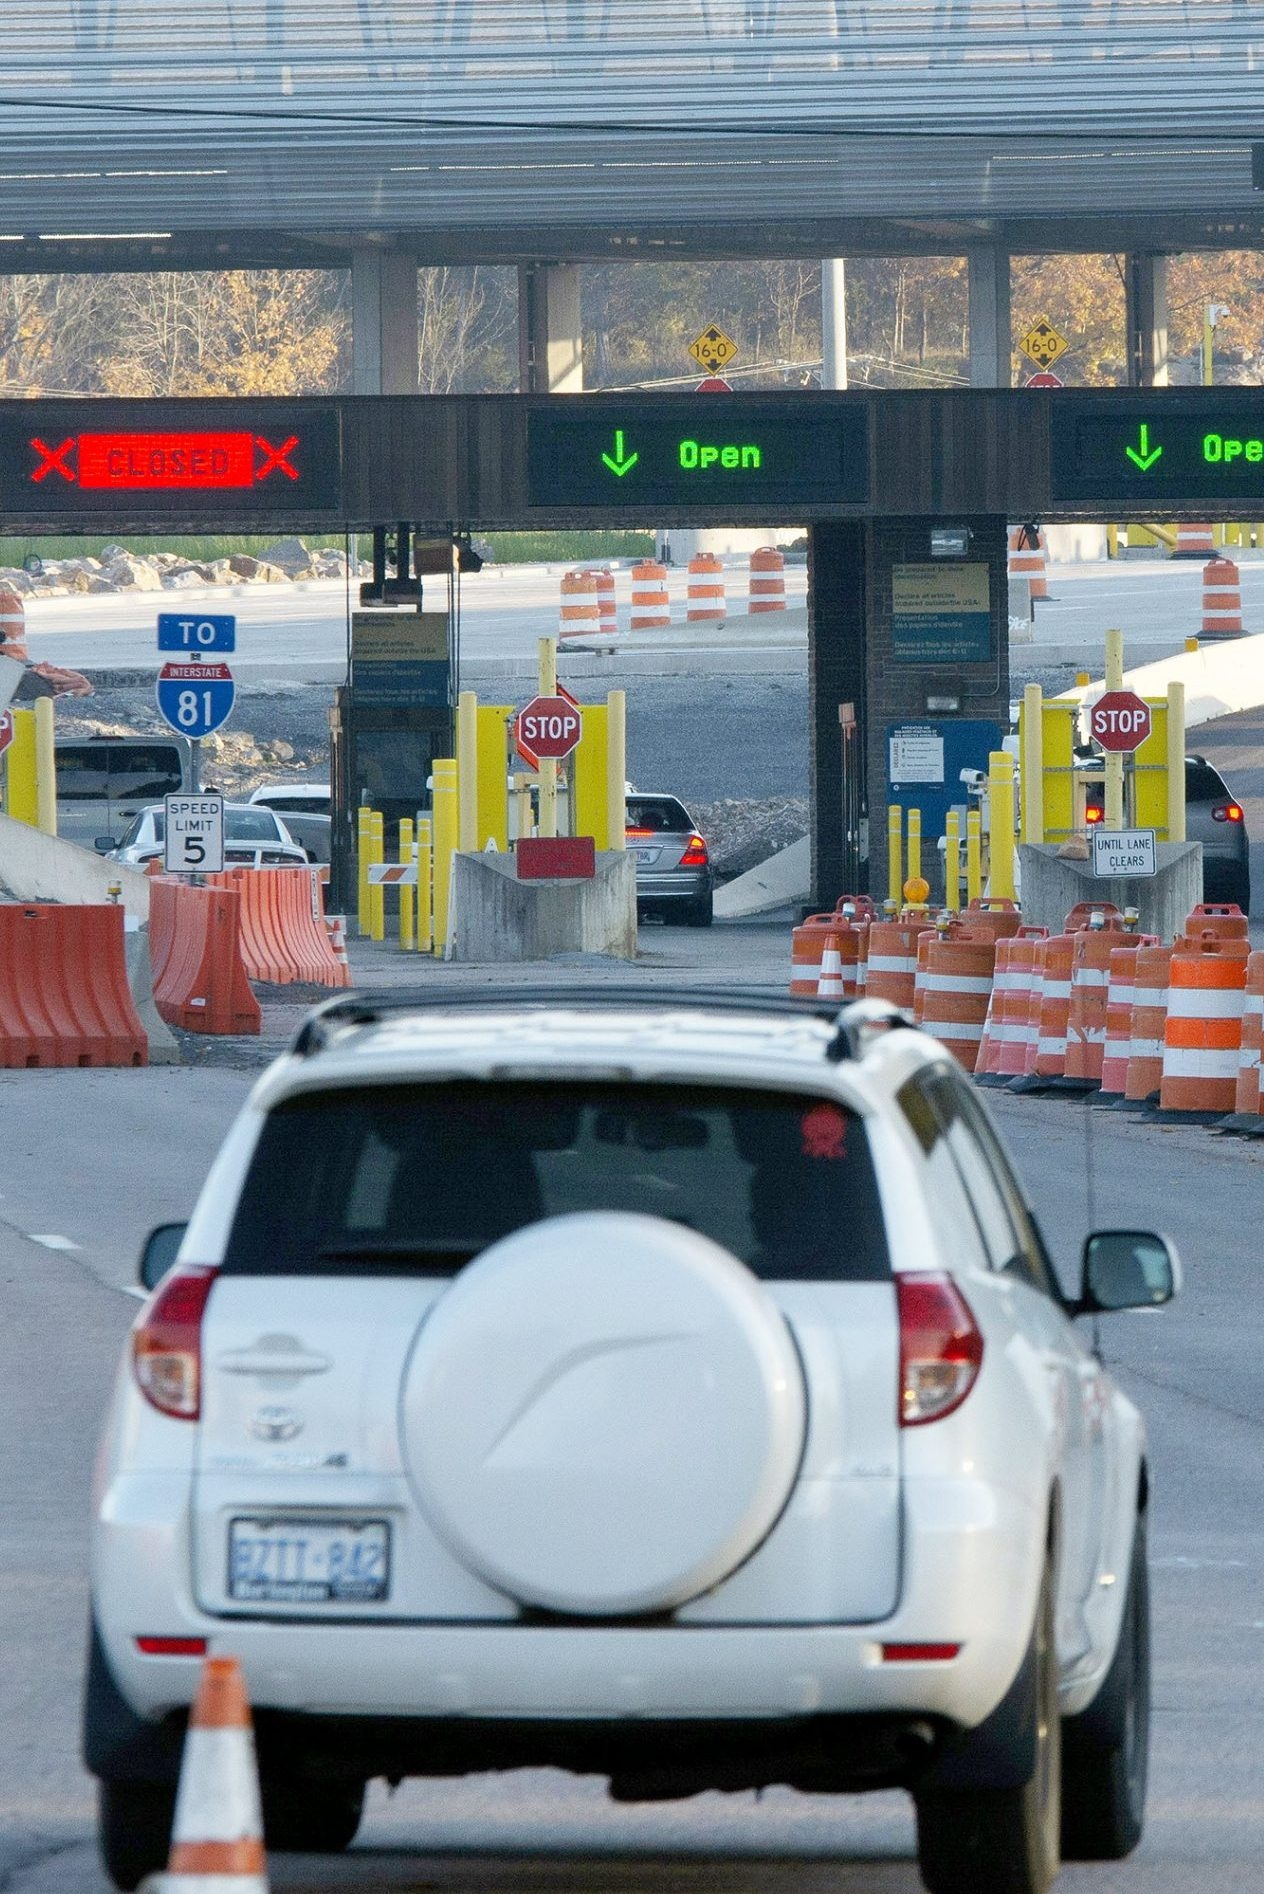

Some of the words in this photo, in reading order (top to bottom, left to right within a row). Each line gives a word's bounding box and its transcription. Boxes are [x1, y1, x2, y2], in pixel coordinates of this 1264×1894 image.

[107, 449, 229, 476] CLOSED
[679, 441, 760, 468] Open
[178, 622, 216, 645] TO
[170, 667, 222, 678] INTERSTATE
[177, 690, 211, 727] 81
[524, 716, 577, 739] STOP
[1094, 709, 1147, 733] STOP
[170, 803, 219, 814] SPEED
[175, 820, 214, 831] LIMIT
[184, 836, 206, 864] 5
[1097, 839, 1124, 850] UNTIL
[1127, 838, 1151, 850] LANE
[1109, 856, 1145, 867] CLEARS
